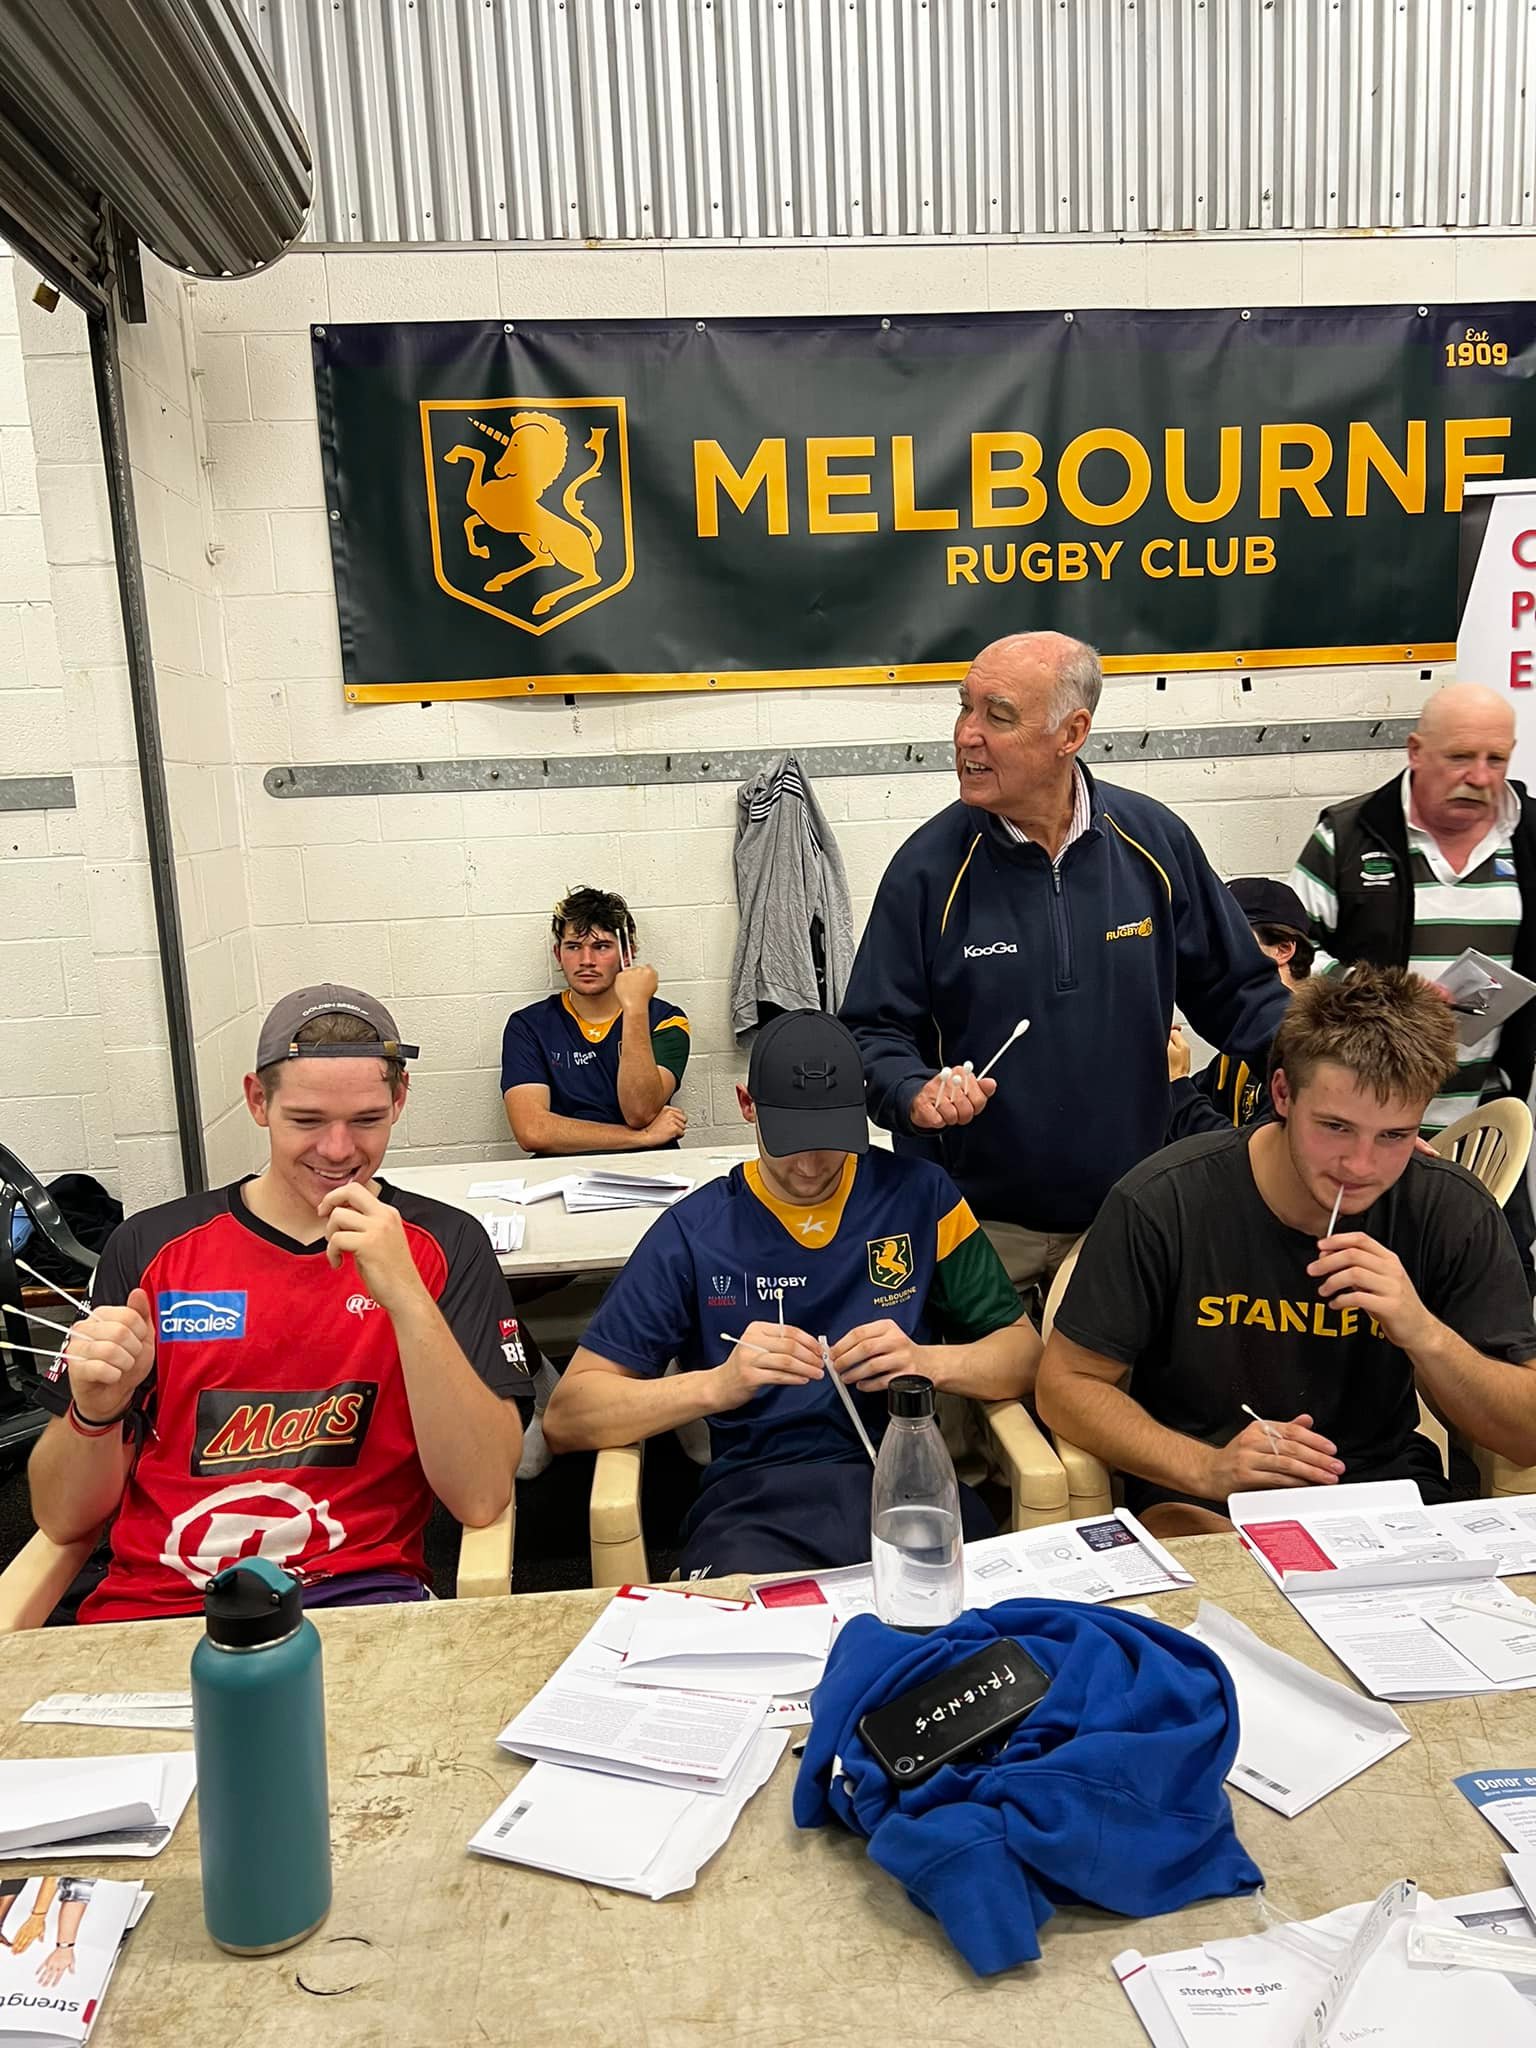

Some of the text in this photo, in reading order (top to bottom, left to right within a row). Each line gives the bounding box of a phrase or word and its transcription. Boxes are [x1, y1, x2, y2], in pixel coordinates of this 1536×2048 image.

[1465, 328, 1489, 341] Est
[1445, 342, 1508, 367] 1909
[694, 417, 1512, 538] MELBOURNE
[946, 534, 1277, 586] RUGBY CLUB
[1106, 926, 1140, 941] RUGBY
[963, 942, 1018, 959] KooGa
[574, 1058, 590, 1066] VIC
[756, 1276, 807, 1289] RUGBY
[203, 1393, 364, 1457] Mars
[1473, 1778, 1521, 1791] Donor
[1179, 1986, 1238, 1998] strength
